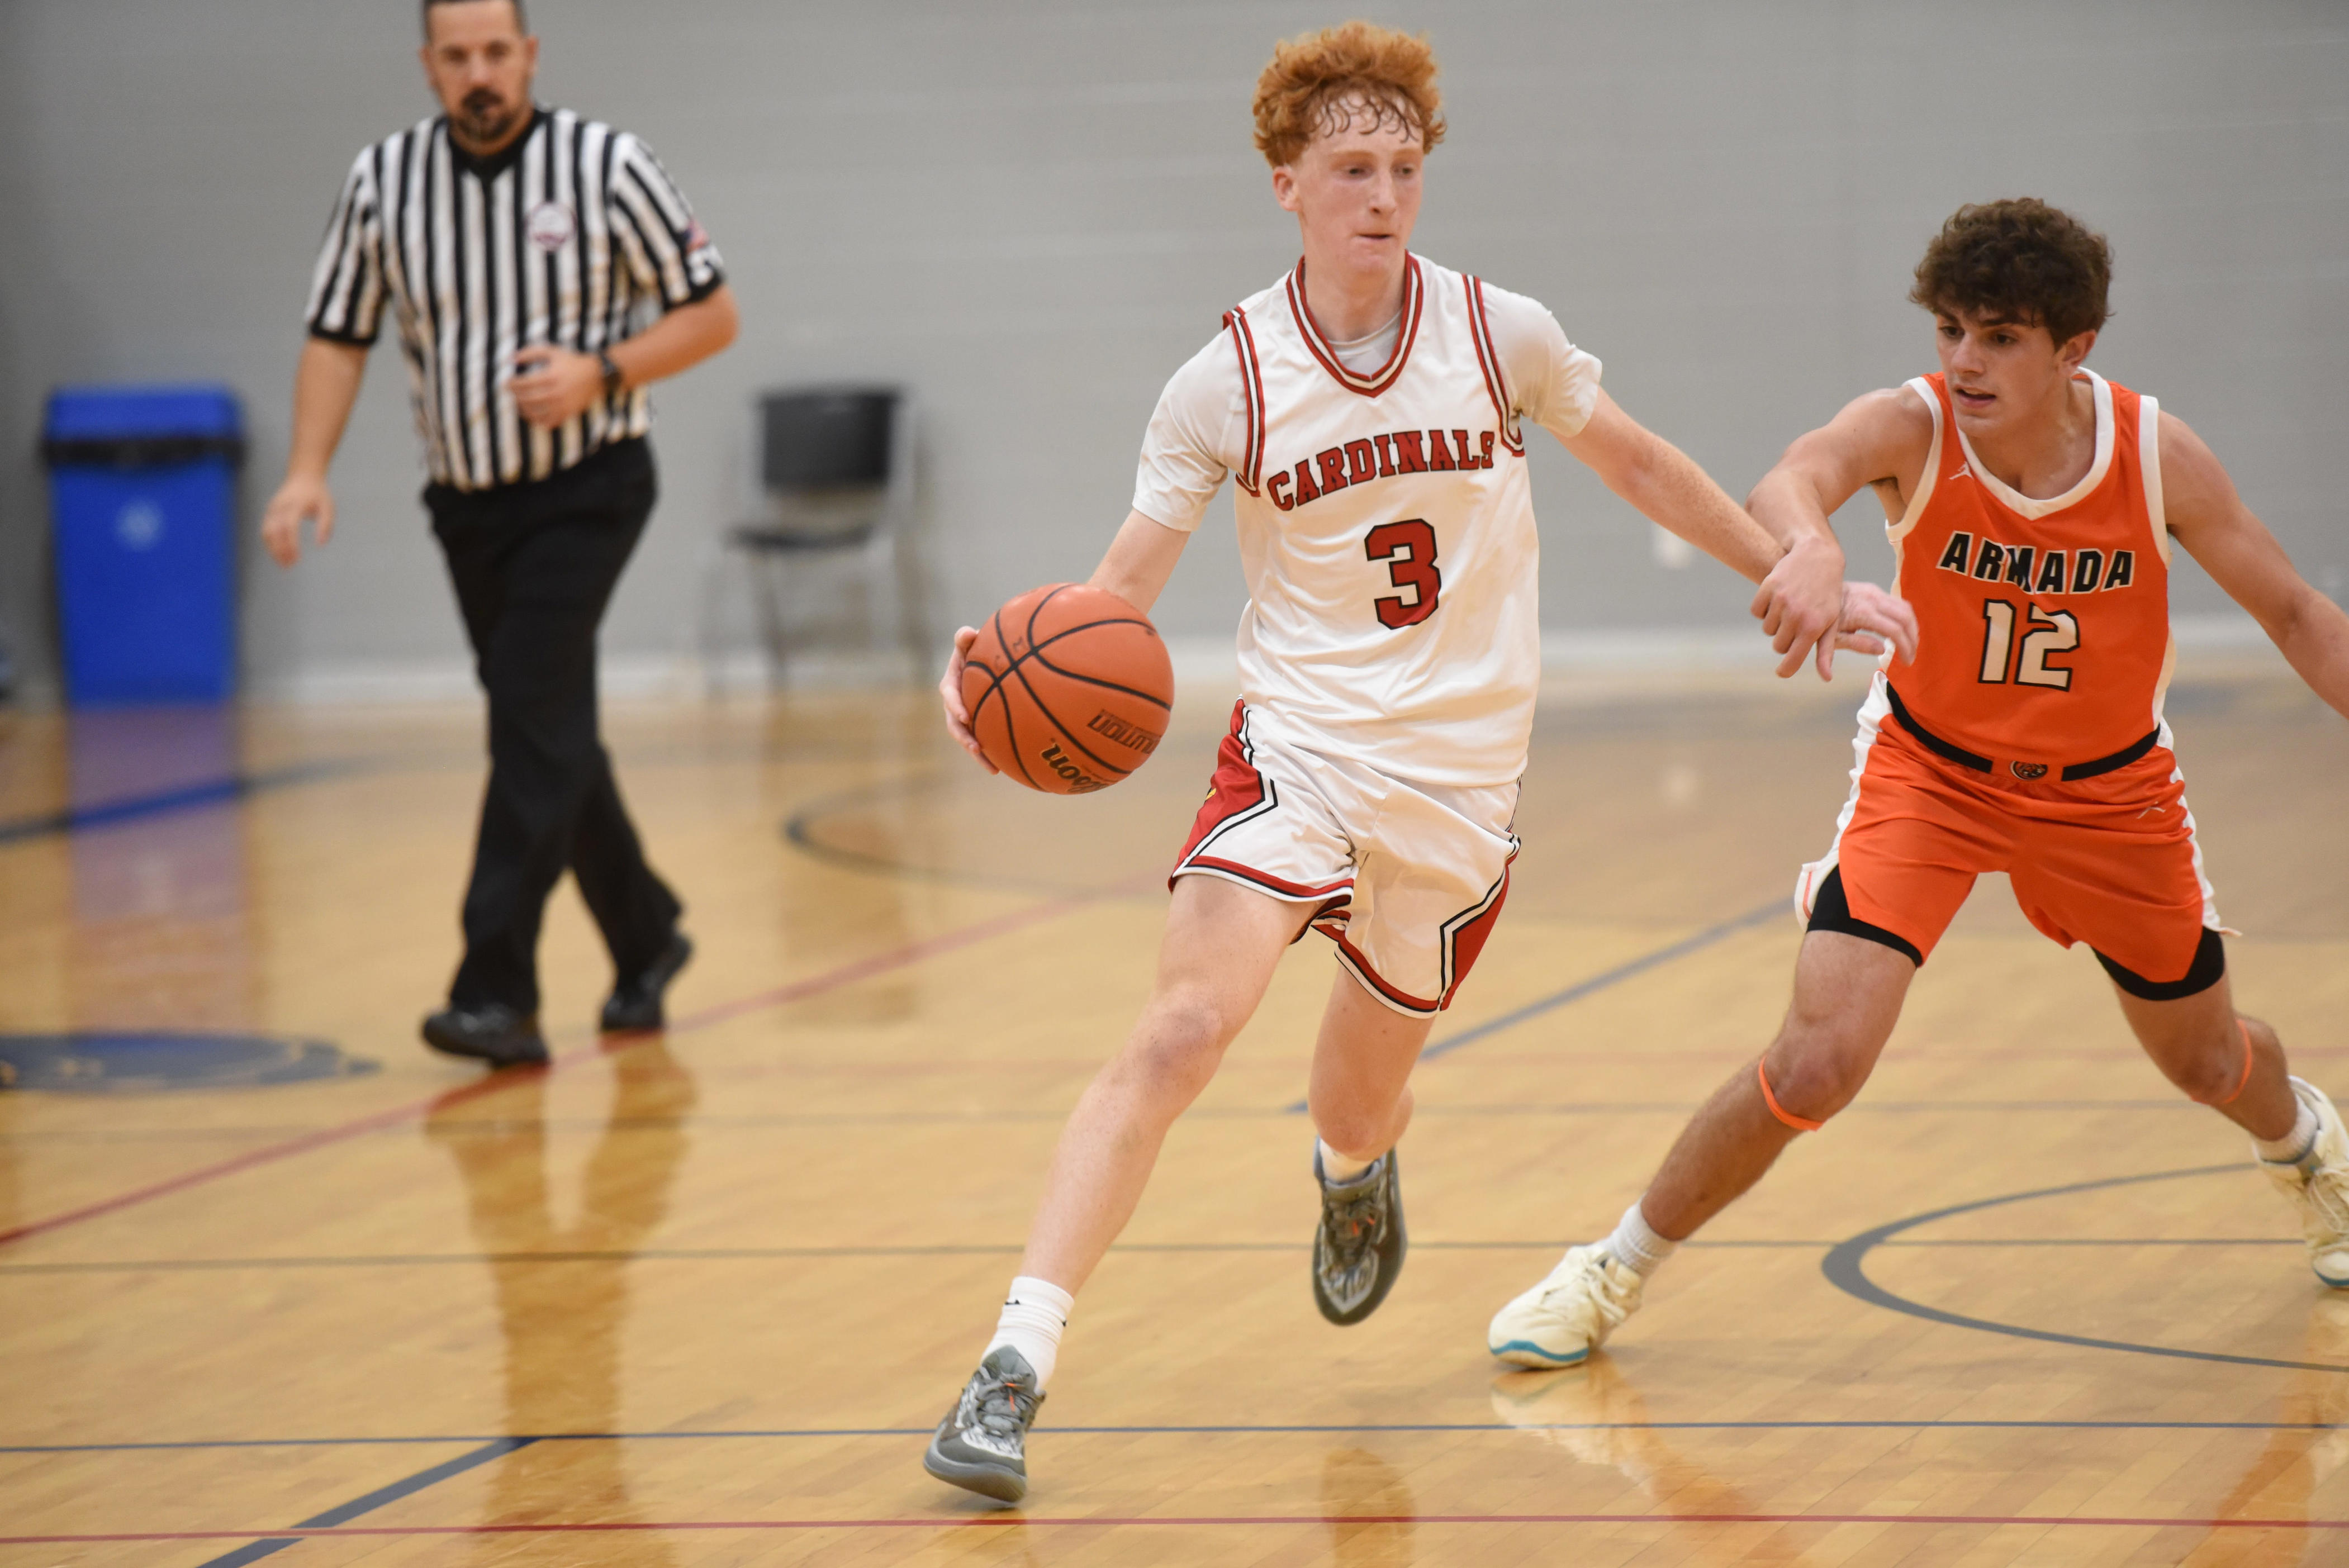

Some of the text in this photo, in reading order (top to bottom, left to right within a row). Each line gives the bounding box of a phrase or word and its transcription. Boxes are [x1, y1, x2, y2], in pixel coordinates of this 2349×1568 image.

[1266, 430, 1495, 511] CARDINALS
[1364, 519, 1441, 630] 3
[1935, 530, 2135, 595] ARMADA
[1977, 598, 2080, 692] 12
